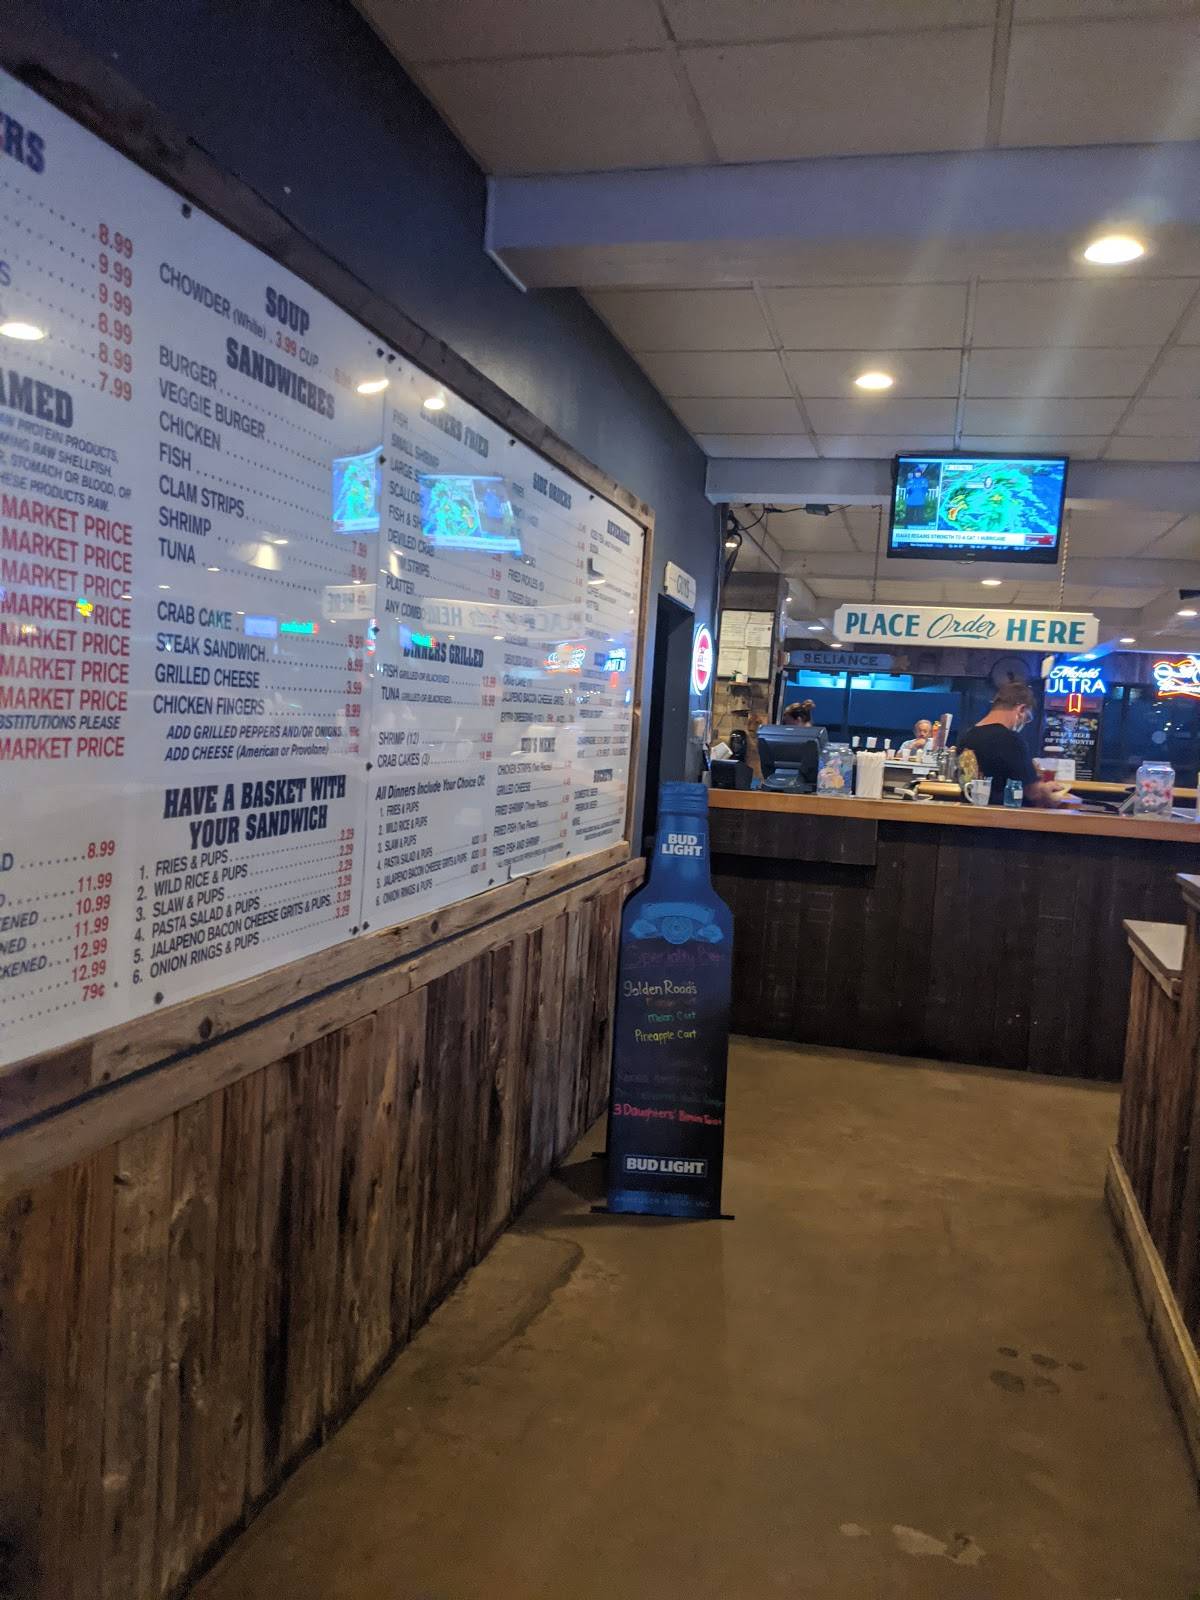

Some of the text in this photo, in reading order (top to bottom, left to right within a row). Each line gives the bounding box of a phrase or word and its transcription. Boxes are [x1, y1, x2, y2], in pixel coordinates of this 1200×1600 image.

[98, 223, 133, 259] 8.99
[98, 253, 132, 288] 9.99
[98, 283, 132, 317] 9.99
[265, 286, 310, 337] SOUP
[98, 312, 132, 346] 8.99
[159, 262, 319, 369] CHOWDER (White) 3.99 CUP
[98, 342, 132, 374] 8.99
[159, 345, 217, 390] BURGER
[98, 371, 132, 403] 7.99
[226, 336, 335, 420] SANDWICHES
[159, 377, 266, 440] VEGGIE BURGER
[17, 418, 64, 444] PROTEIN
[159, 411, 221, 451] CHICKEN
[32, 442, 57, 460] RAW
[159, 442, 192, 471] FISH
[11, 453, 62, 479] STOMACH
[64, 470, 79, 484] OR
[118, 486, 132, 499] OR
[30, 480, 85, 506] PRODUCTS
[159, 474, 246, 519] CLAM STRIPS
[1, 494, 133, 546] MARKET PRICE
[159, 505, 212, 538] SHRIMP
[1, 525, 133, 574] MARKET PRICE
[159, 537, 196, 565] TUNA
[1, 558, 132, 600] MARKET PRICE
[0, 591, 77, 622] MARKET
[157, 600, 232, 630] CRAB CAKE
[385, 599, 400, 614] ANY
[845, 611, 1086, 645] PLACE Order HERE
[82, 631, 130, 657] PRICE
[156, 632, 266, 663] STEAK SANDWICH
[449, 643, 484, 668] GRILLED
[0, 653, 130, 684] MARKET PRICE
[804, 654, 879, 667] RELIANCE
[155, 663, 260, 689] GRILLED CHEESE
[1047, 679, 1106, 694] ULTRA
[0, 685, 128, 711] MARKET PRICE
[153, 694, 265, 716] CHICKEN FINGERS
[382, 686, 399, 701] TUNA
[79, 715, 122, 730] PLEASE
[166, 726, 191, 740] ADD
[193, 726, 237, 739] GRILLED
[239, 726, 280, 739] PEPPERS
[281, 726, 313, 738] AND/OR
[0, 736, 125, 760] MARKET PRICE
[164, 748, 189, 761] ADD
[192, 745, 233, 760] CHEESE
[236, 744, 279, 761] (American
[280, 747, 290, 756] or
[378, 732, 405, 746] SHRIMP
[377, 753, 420, 768] CRAB CAKES
[163, 774, 347, 819] HAVE A BASKET WITH
[376, 786, 387, 800] All
[388, 784, 416, 799] Dinners
[417, 781, 441, 796] Include
[442, 779, 456, 792] Your
[457, 777, 475, 790] Choice
[189, 805, 328, 850] YOUR SANDWICH
[668, 833, 698, 845] BUD
[87, 841, 116, 859] 8.99
[139, 849, 228, 880] 1. FRIES & PUPS
[661, 843, 703, 857] LIGHT
[78, 872, 113, 893] 11.99
[137, 864, 248, 901] 2. WILD RICE & PUPS
[76, 894, 111, 915] 10.99
[135, 896, 260, 942] 4. PASTA SALAD & PUPS
[136, 887, 225, 922] 3. SLAW & PUPS
[74, 916, 109, 938] 11.99
[133, 894, 331, 964] 5. JALAPENO BACON CHEESE GRITS & PUPS
[73, 938, 108, 960] 12.99
[132, 931, 260, 984] 6. ONION RINGS & PUPS
[72, 960, 107, 982] 12.99
[634, 1028, 697, 1044] Pineapple Cart
[613, 1103, 622, 1116] 3
[626, 1157, 705, 1175] BUD LIGHT
